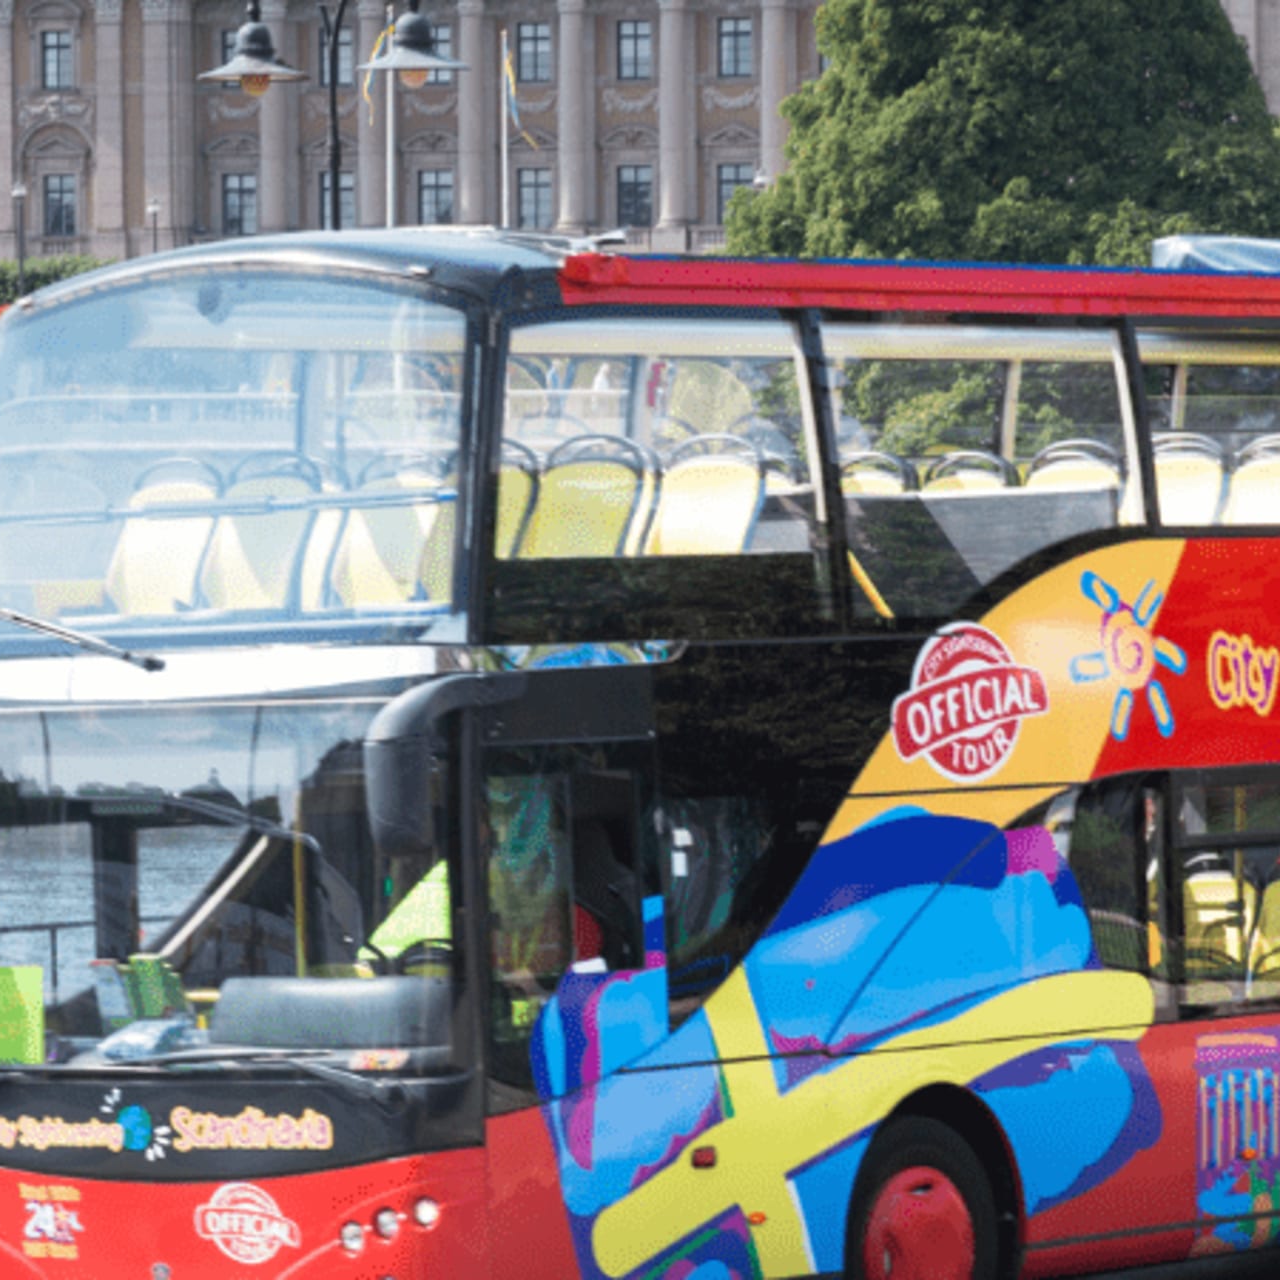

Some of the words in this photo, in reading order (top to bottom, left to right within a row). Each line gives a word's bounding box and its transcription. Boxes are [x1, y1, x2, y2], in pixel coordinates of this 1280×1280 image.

[1208, 631, 1280, 716] City
[906, 673, 1041, 745] OFFICIAL
[951, 726, 1010, 771] TOUR
[170, 1105, 334, 1152] Scandinavia
